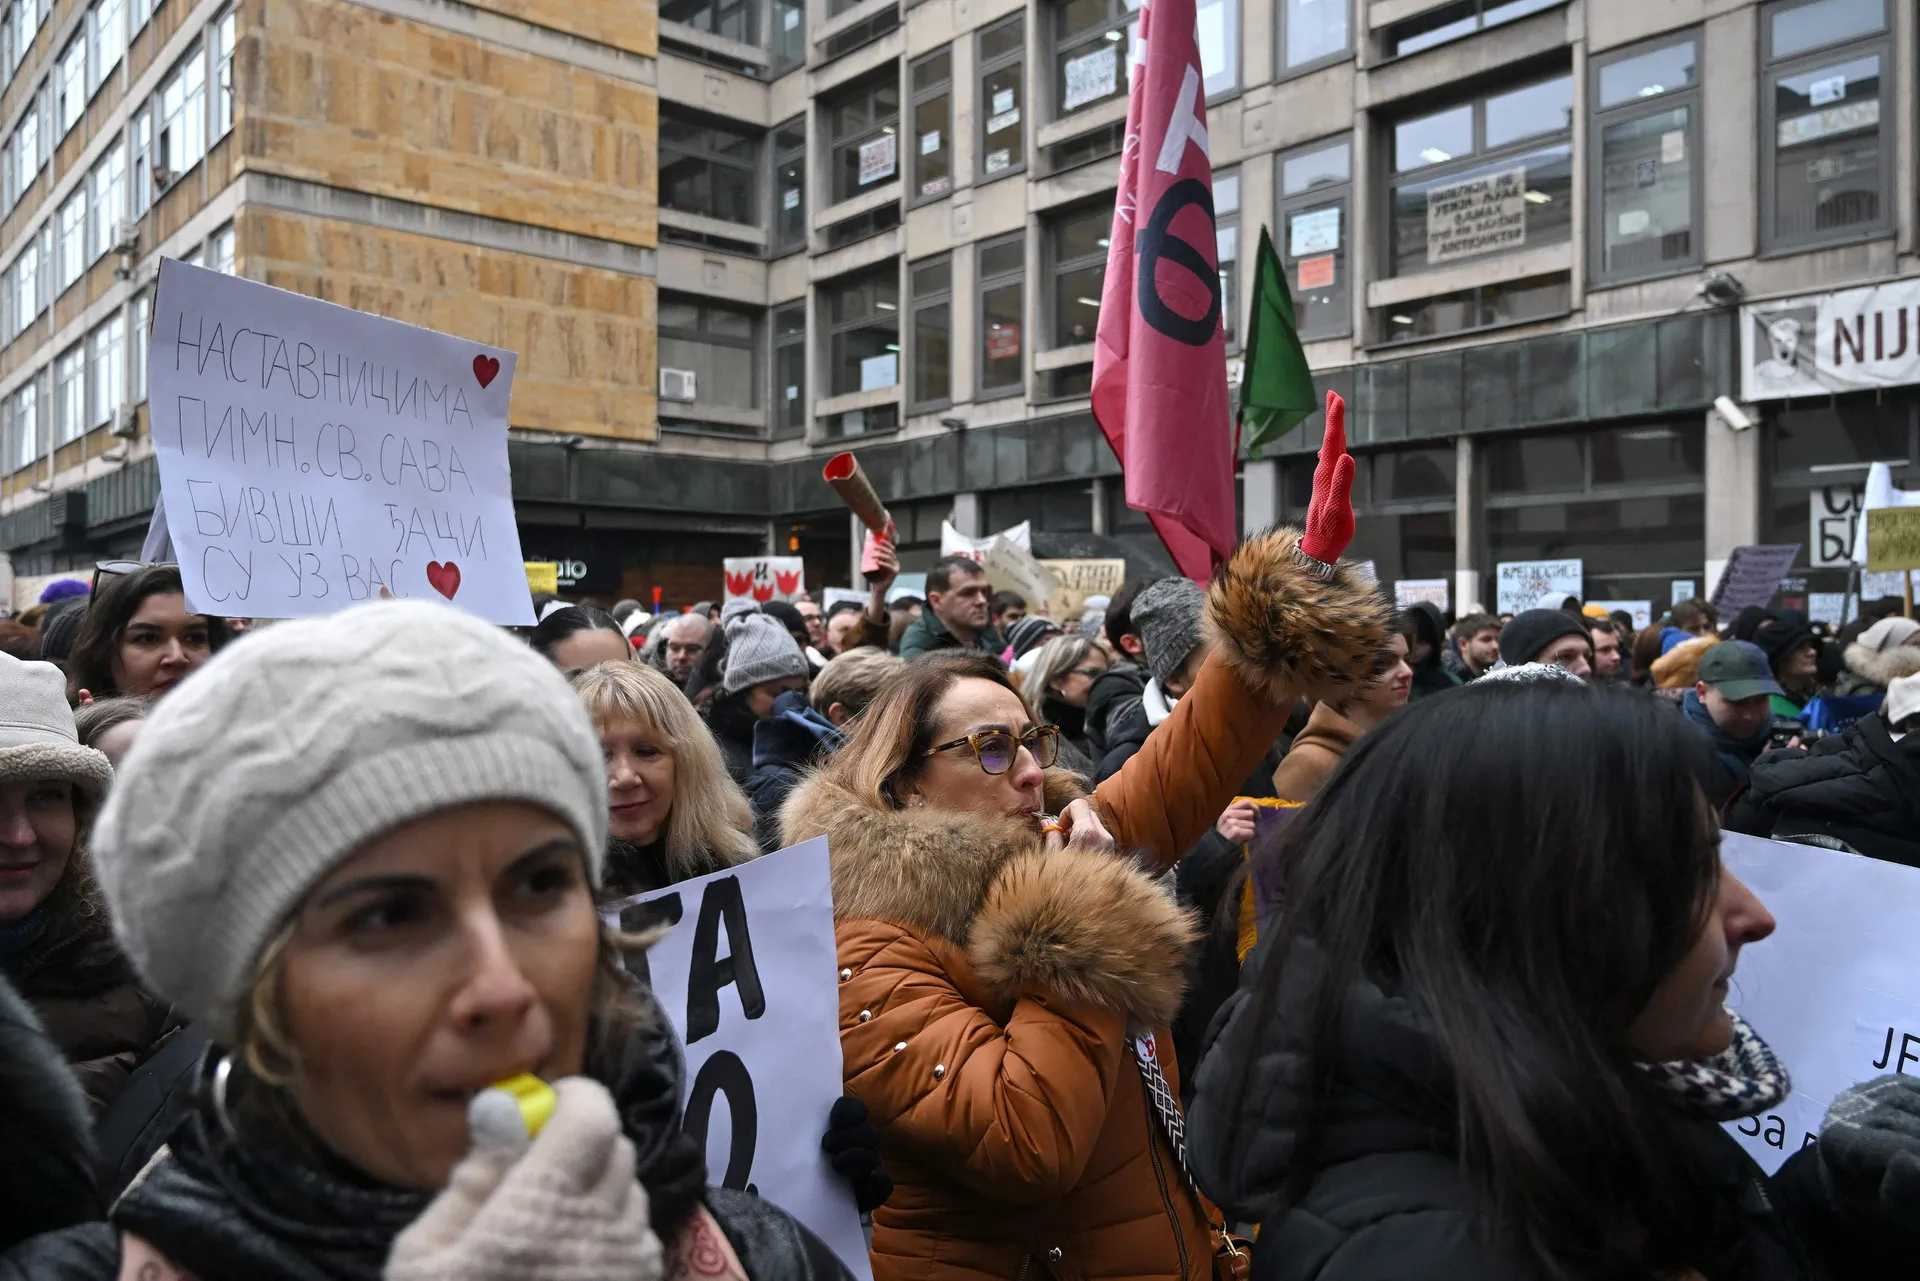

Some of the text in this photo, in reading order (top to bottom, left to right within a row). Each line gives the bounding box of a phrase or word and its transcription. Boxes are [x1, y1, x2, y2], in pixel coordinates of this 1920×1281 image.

[177, 312, 474, 430] НАСТАВНИЦИМА
[1832, 306, 1920, 367] NIJ
[187, 479, 488, 562] БИВШИ ЂАЦИ
[203, 545, 408, 602] СУ УЗ ВАС
